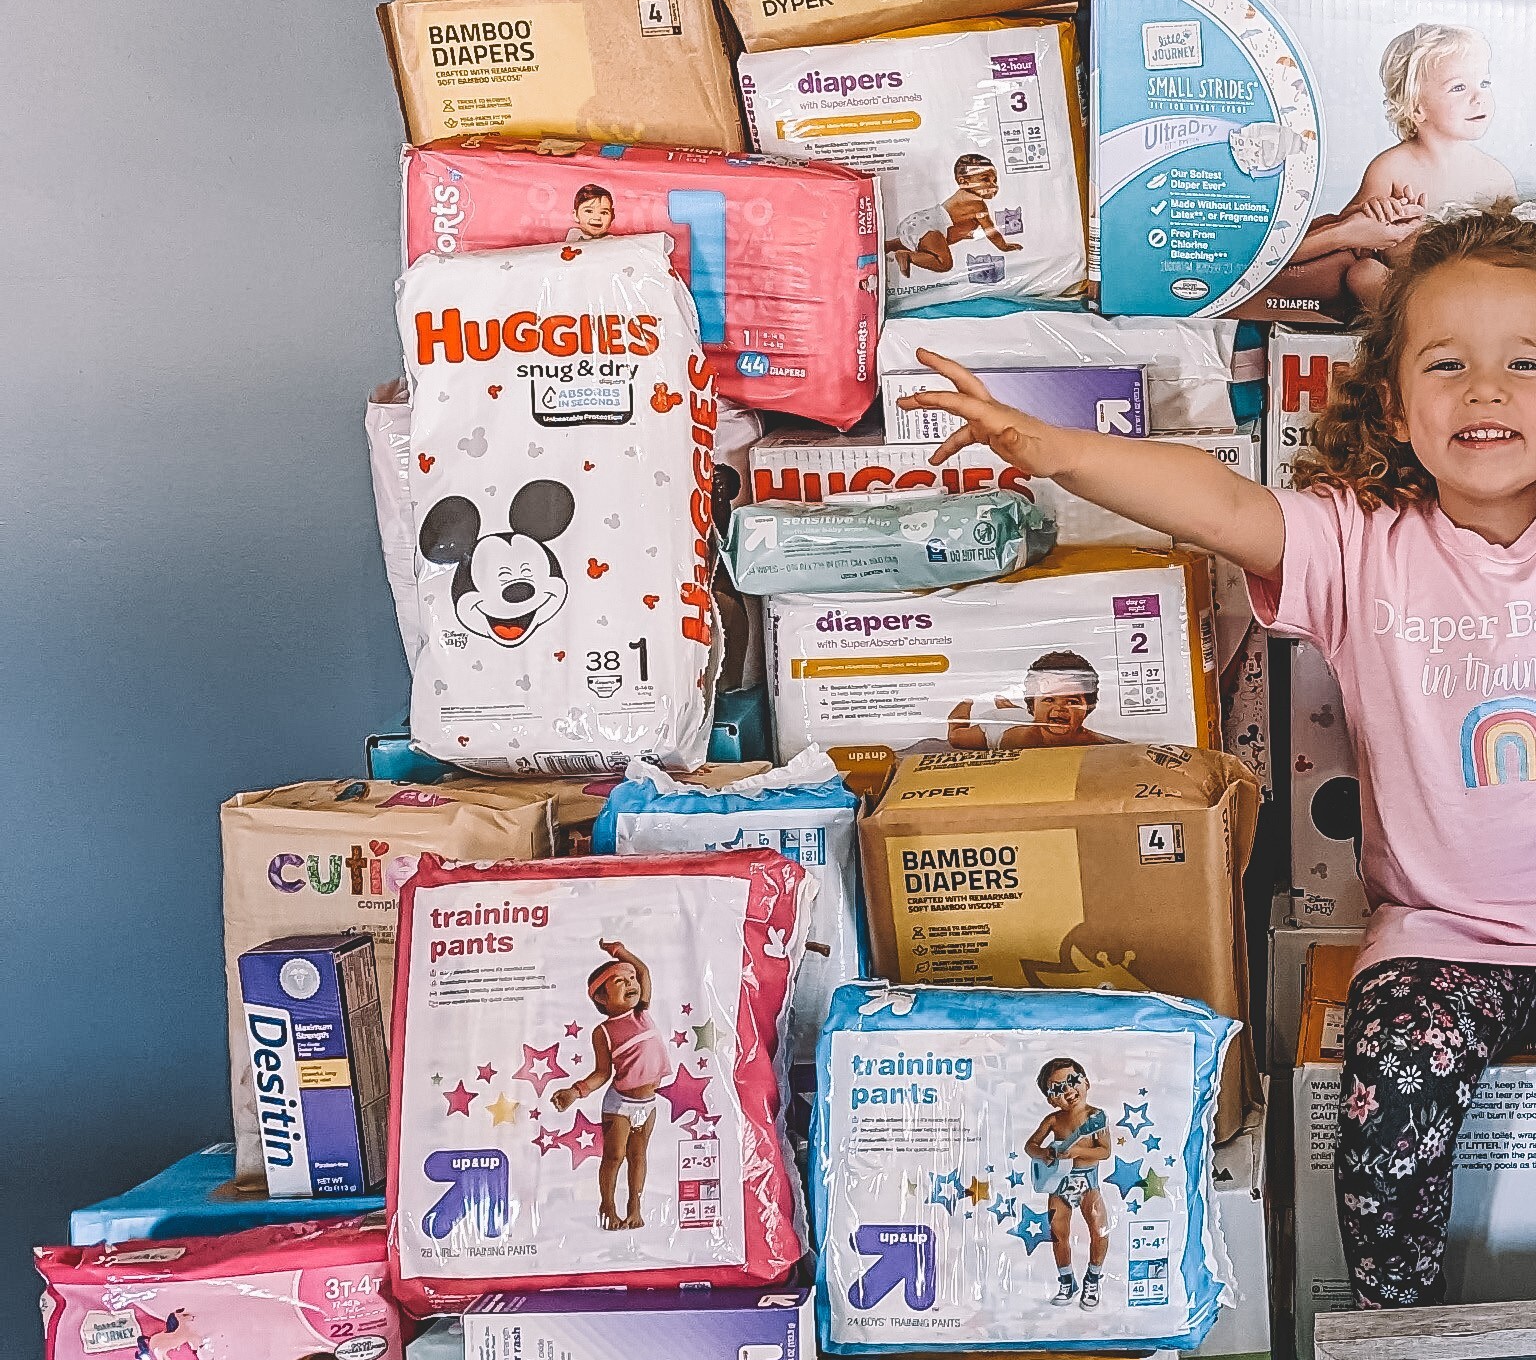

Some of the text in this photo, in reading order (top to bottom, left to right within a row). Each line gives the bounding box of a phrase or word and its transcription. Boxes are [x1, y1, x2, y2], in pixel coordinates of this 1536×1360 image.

[648, 3, 662, 23] 4
[432, 42, 535, 67] DIAPERS
[1152, 46, 1196, 61] JOURNEY
[798, 70, 903, 96] diapers
[1148, 76, 1254, 101] SMALL STRIDES
[1170, 239, 1208, 251] Chlorine
[668, 190, 726, 343] 1
[816, 608, 933, 637] diapers
[1374, 598, 1501, 654] Diaper
[1130, 633, 1150, 655] 2
[586, 651, 621, 672] 38
[848, 751, 888, 763] up&up
[901, 785, 971, 800] DYPER
[904, 868, 1020, 894] DIAPERS
[430, 901, 550, 930] training
[430, 932, 515, 963] pants
[851, 1051, 974, 1082] training
[248, 1011, 296, 1171] Desitin
[851, 1082, 938, 1110] pants
[451, 1155, 501, 1172] up&up
[1458, 1152, 1488, 1160] comes
[1490, 1151, 1510, 1160] from
[1511, 1151, 1525, 1159] the
[330, 1323, 354, 1338] 22
